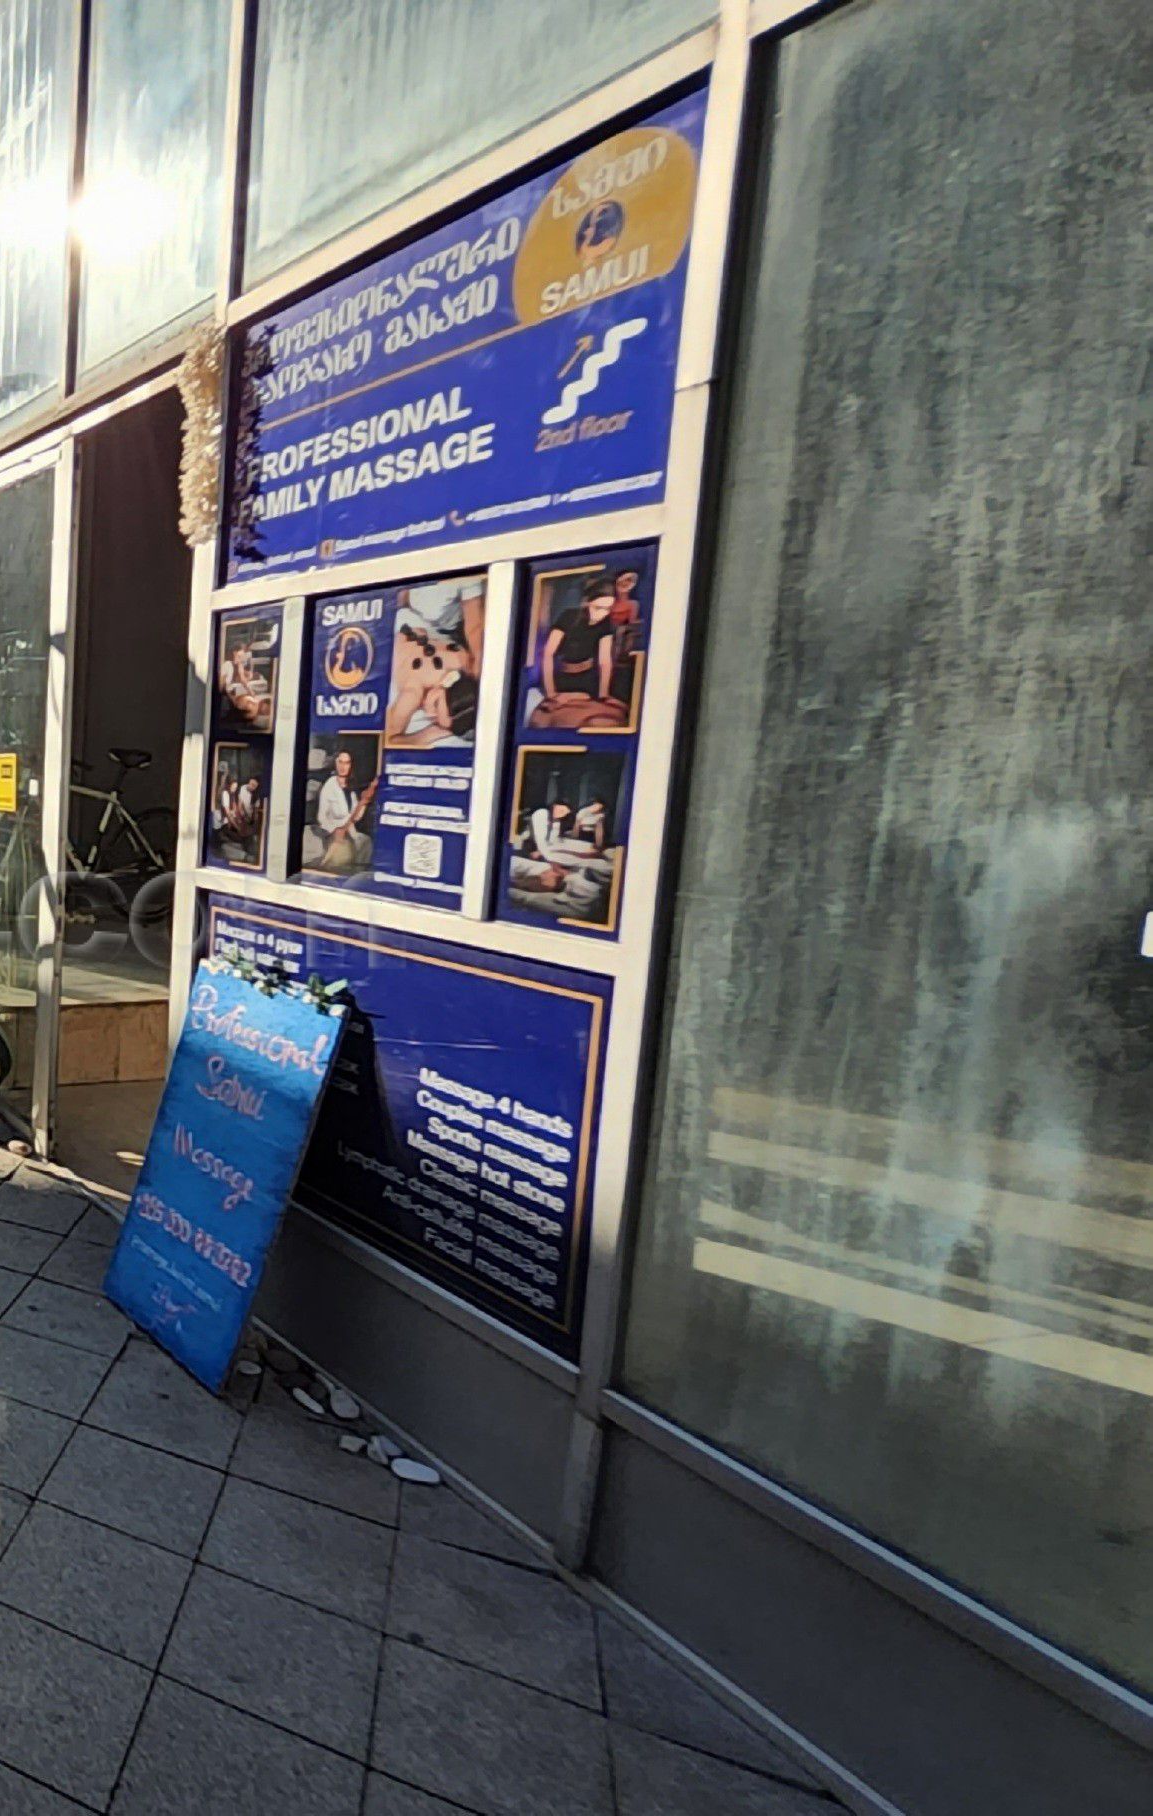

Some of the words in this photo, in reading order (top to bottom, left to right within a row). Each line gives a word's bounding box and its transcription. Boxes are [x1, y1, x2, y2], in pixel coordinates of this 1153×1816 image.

[539, 244, 650, 314] SAMUI
[328, 422, 495, 502] MASSAGE
[321, 599, 383, 627] SAMUI
